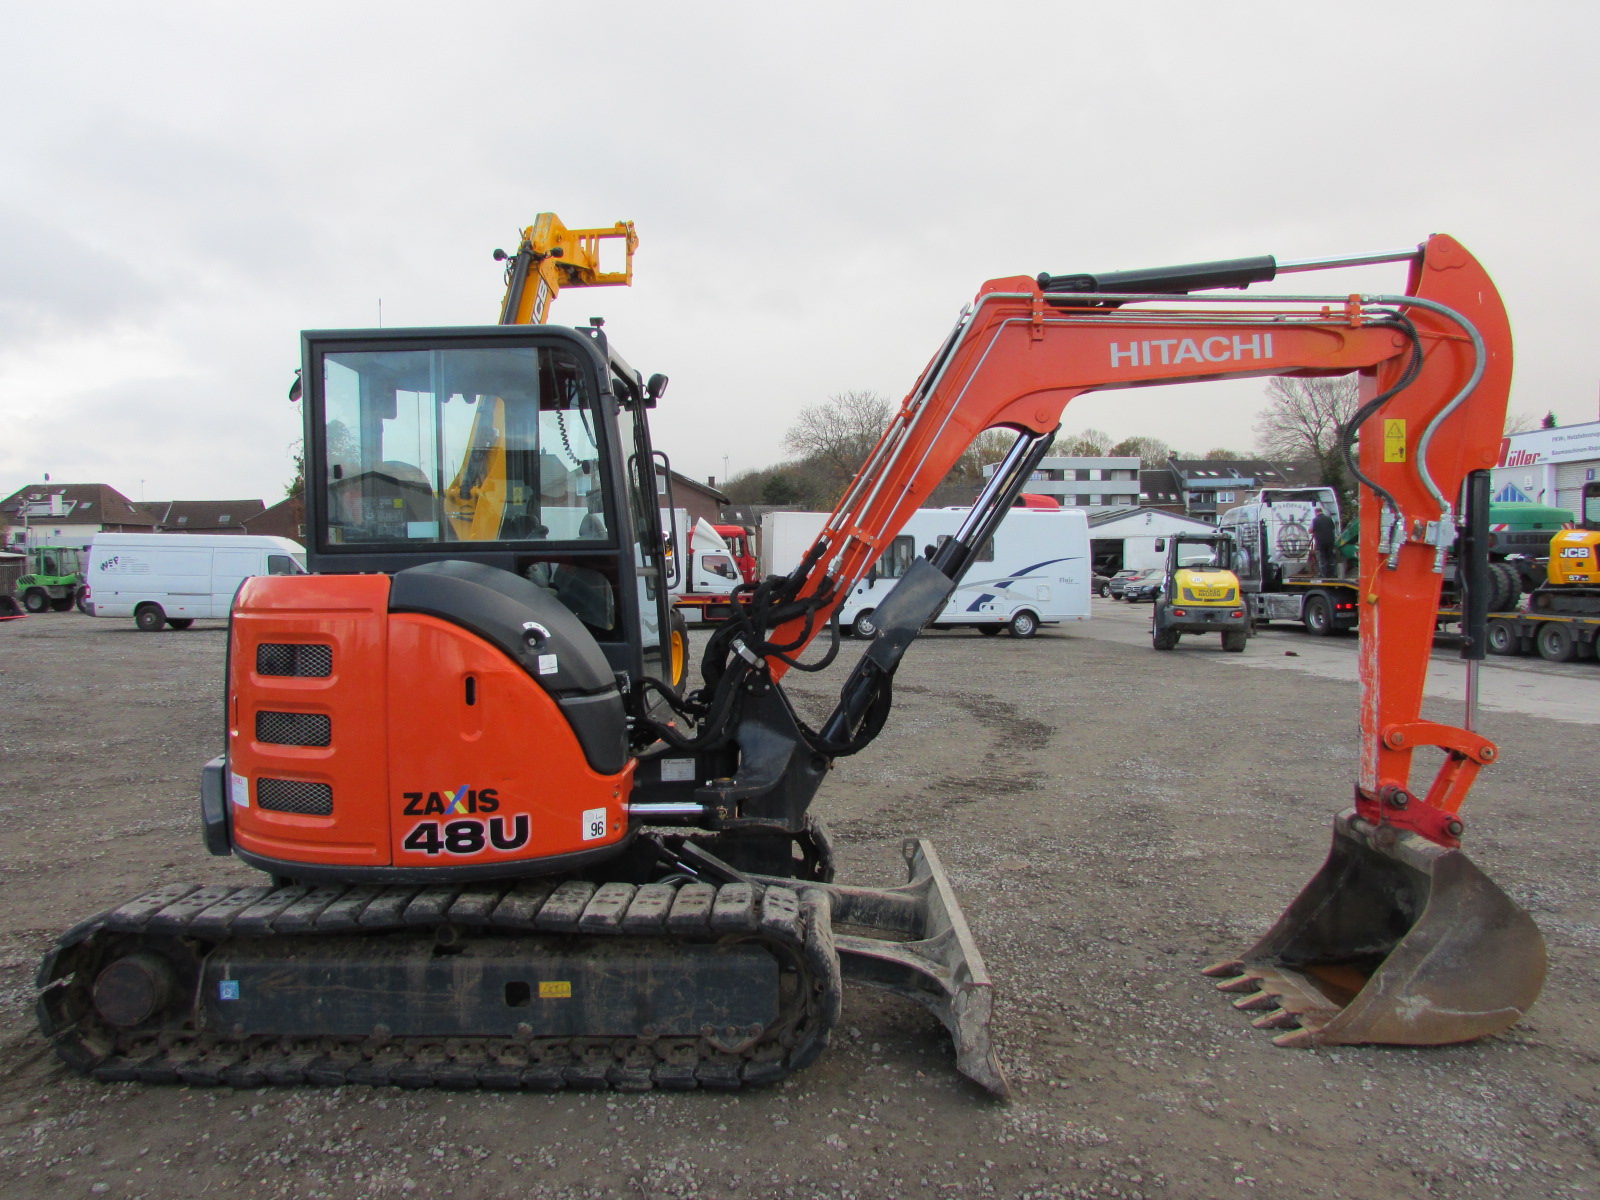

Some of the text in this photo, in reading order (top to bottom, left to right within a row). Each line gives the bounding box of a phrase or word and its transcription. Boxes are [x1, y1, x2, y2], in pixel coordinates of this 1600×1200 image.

[1110, 333, 1273, 368] HITACHI
[1560, 548, 1589, 558] JCB
[403, 784, 499, 815] ZAXIS
[403, 814, 530, 855] 48U
[591, 821, 604, 837] 96
